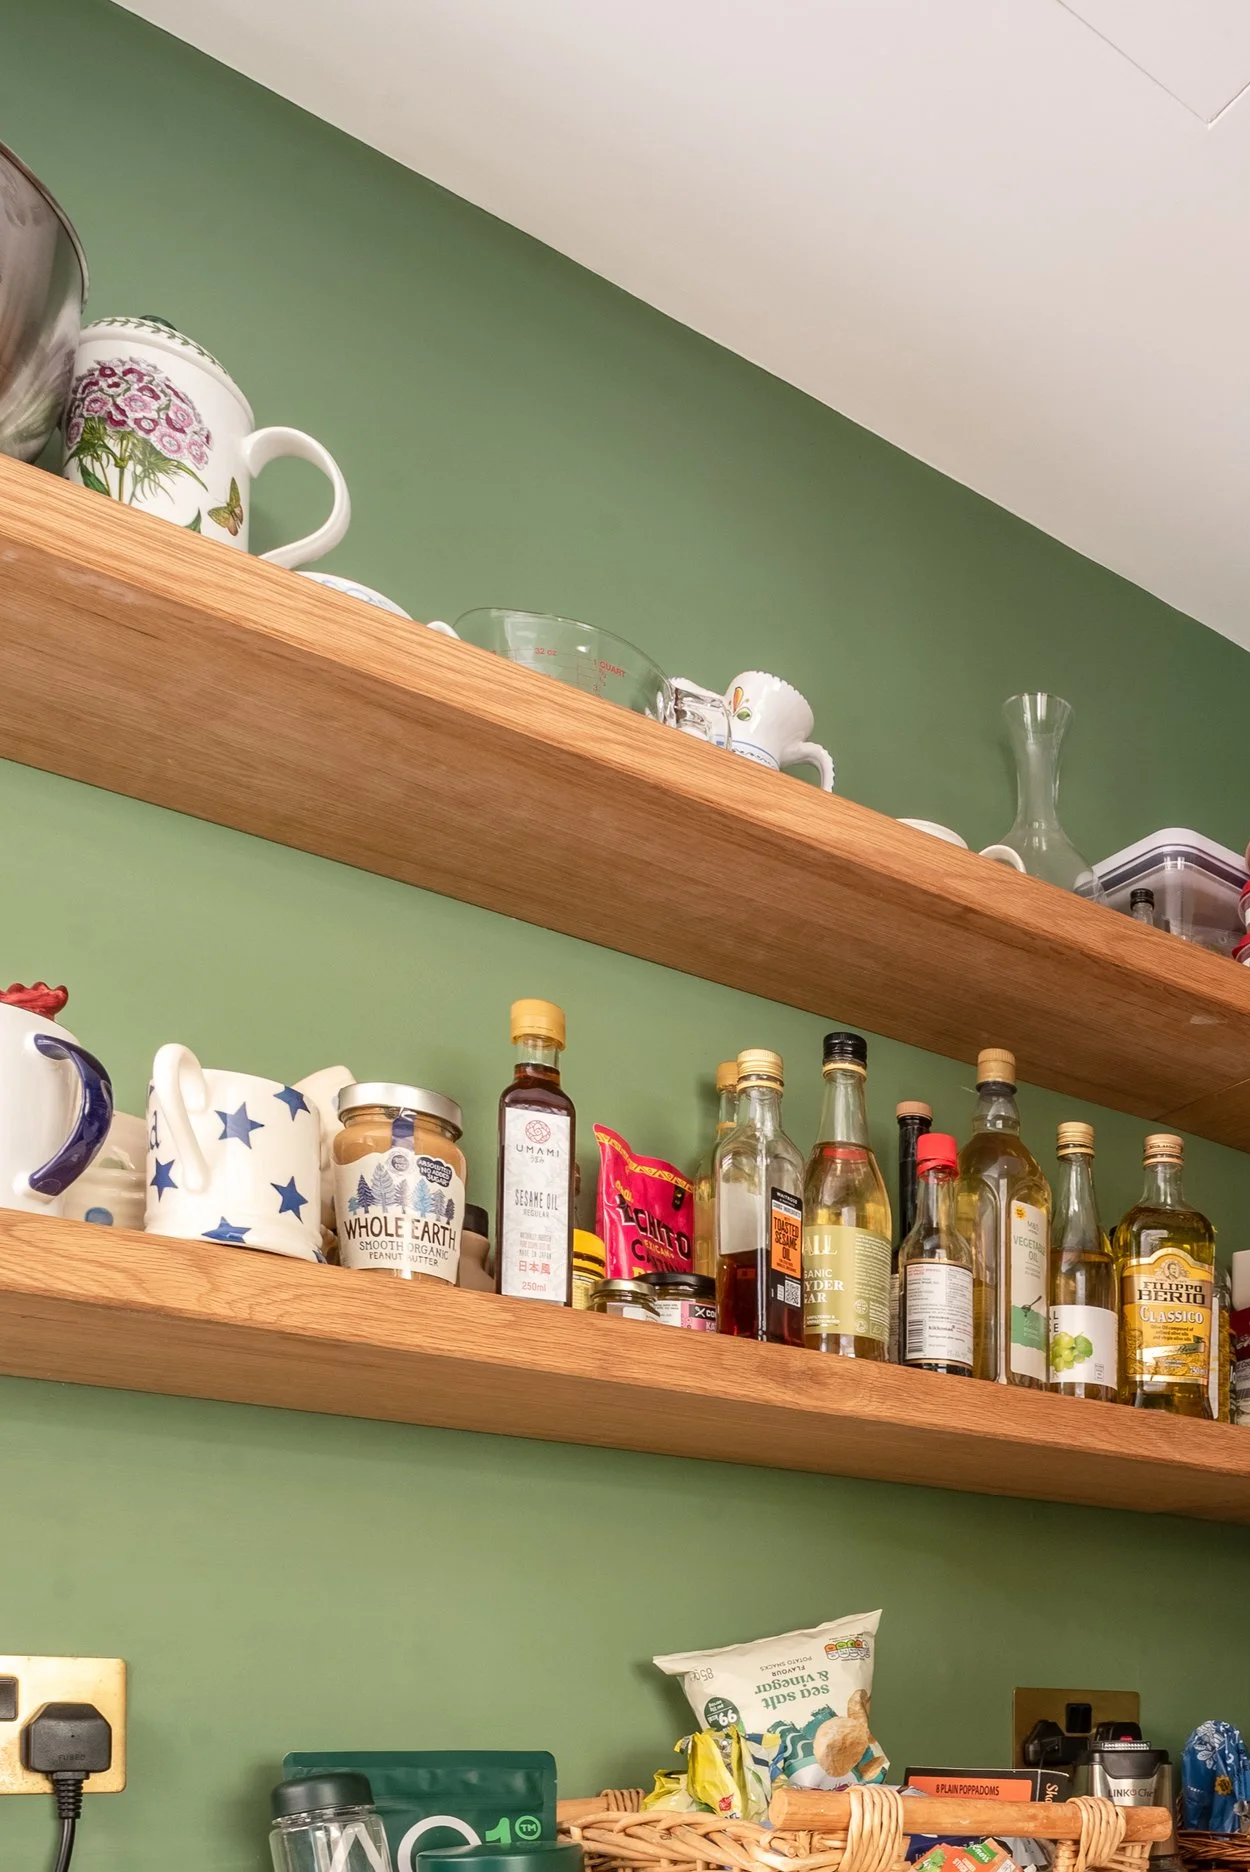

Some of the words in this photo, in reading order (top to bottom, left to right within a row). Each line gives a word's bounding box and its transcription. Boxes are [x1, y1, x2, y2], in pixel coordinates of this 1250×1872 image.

[599, 661, 626, 677] QUART
[515, 1143, 560, 1157] UMAMI
[514, 1188, 544, 1209] SESAME
[546, 1193, 559, 1211] OIL
[523, 1207, 550, 1218] REGULAR
[344, 1216, 404, 1240] WHOLE
[411, 1219, 457, 1251] EARTH
[773, 1216, 800, 1238] TOASTED
[359, 1240, 404, 1251] SMOOTH
[774, 1230, 798, 1251] SESAME
[1013, 1235, 1046, 1257] VEGETABLE
[369, 1251, 403, 1260] PEANUT
[782, 1246, 792, 1261] OIL
[1028, 1250, 1039, 1263] OIL
[518, 1260, 551, 1275] 日本風
[521, 1280, 547, 1292] 250ml
[1142, 1281, 1203, 1293] FILIPPO
[1136, 1289, 1206, 1305] BERIO
[1139, 1305, 1205, 1325] CLASSICO
[759, 1663, 786, 1672] SNACKS
[786, 1655, 813, 1667] POTATO
[771, 1665, 806, 1677] FLAVOUR
[817, 1670, 830, 1682] &
[754, 1673, 817, 1694] vinegar
[800, 1683, 831, 1700] sea
[761, 1692, 798, 1711] salt
[718, 1709, 738, 1726] 99
[935, 1784, 940, 1794] 8
[940, 1784, 959, 1795] PLAIN
[958, 1785, 1000, 1797] POPPADOMS
[1108, 1789, 1130, 1798] LINK
[519, 1823, 538, 1833] TM
